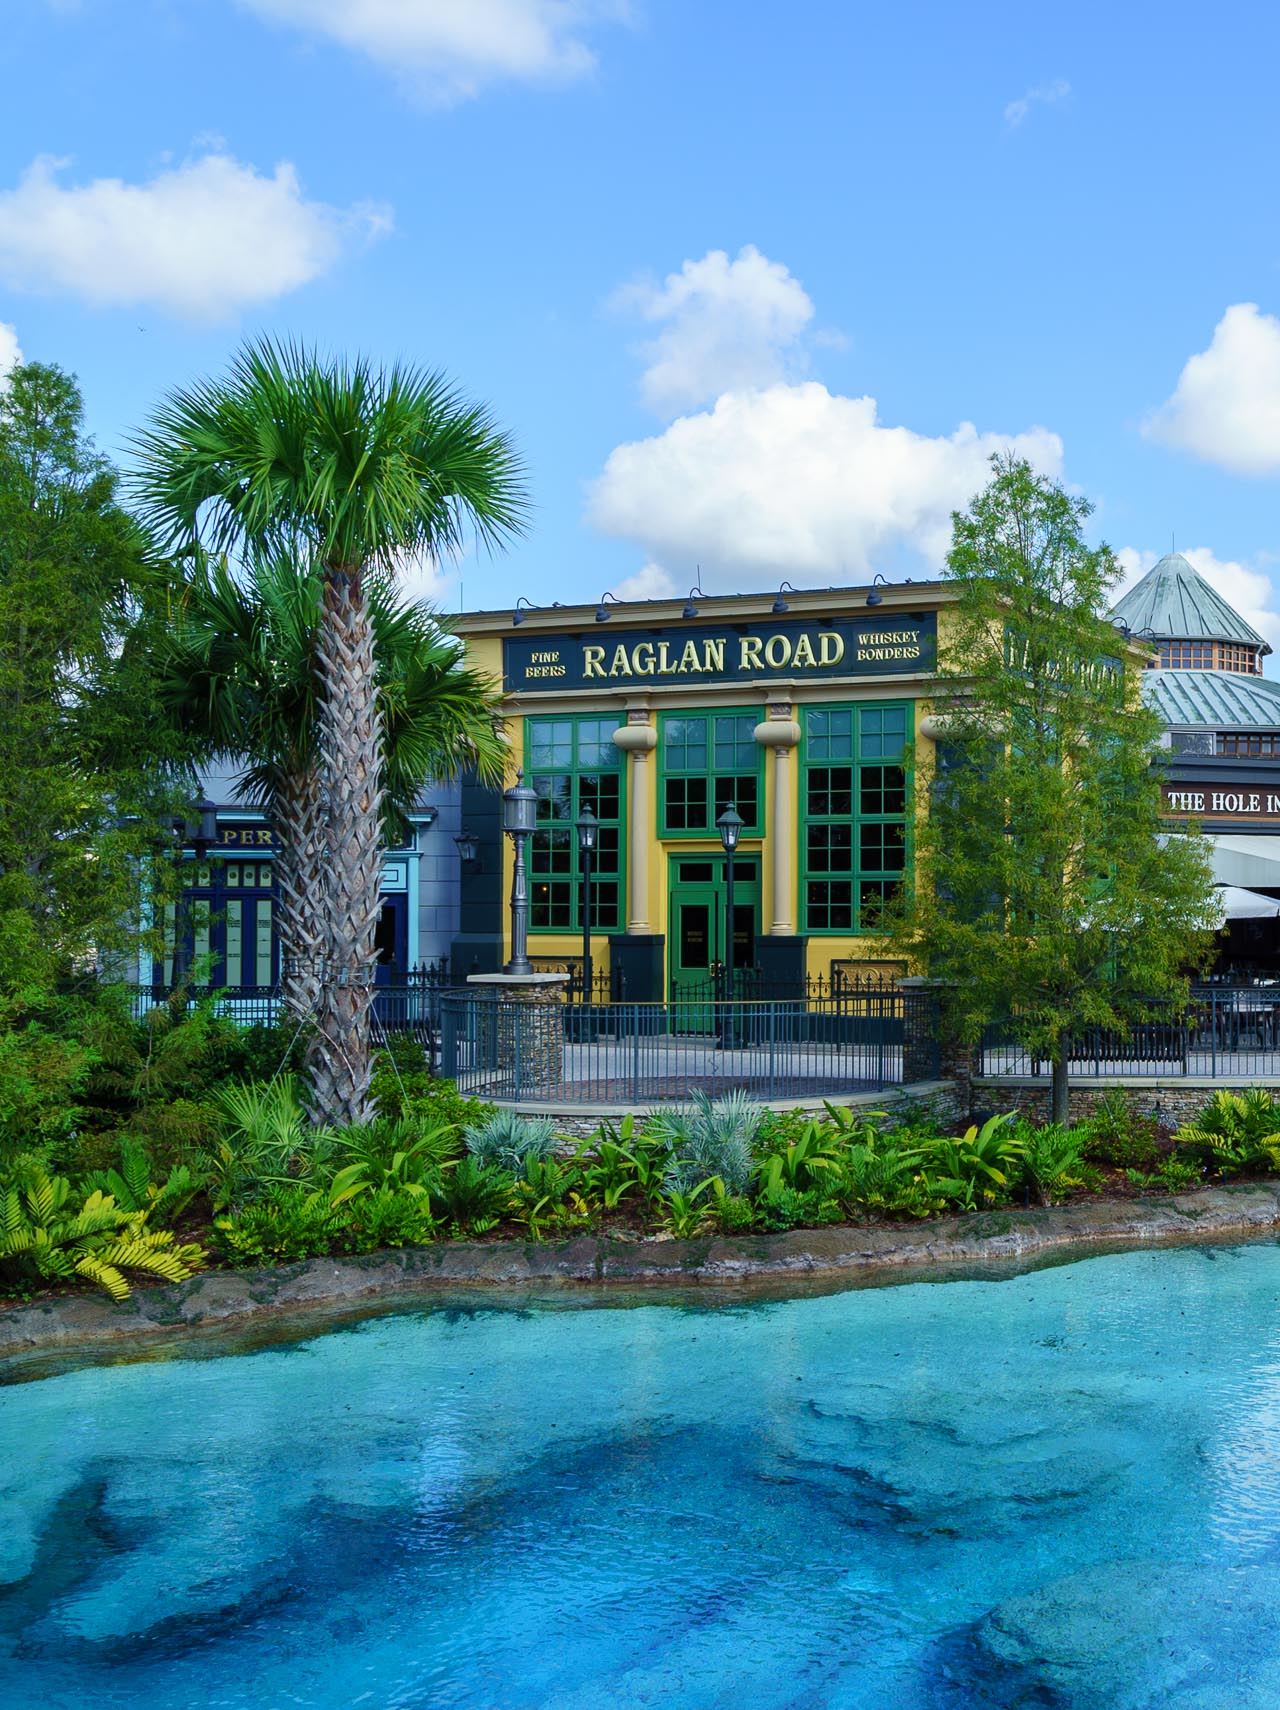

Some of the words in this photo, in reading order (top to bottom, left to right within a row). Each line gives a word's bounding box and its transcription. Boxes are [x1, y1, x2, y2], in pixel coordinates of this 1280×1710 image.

[858, 631, 920, 645] WHISKEY
[531, 651, 560, 664] FINE
[582, 638, 726, 679] RAGLAN
[738, 632, 845, 671] ROAD
[857, 646, 920, 661] BONDERS
[525, 665, 566, 678] BEERS
[1168, 791, 1206, 812] THE
[1211, 793, 1262, 812] HOLE
